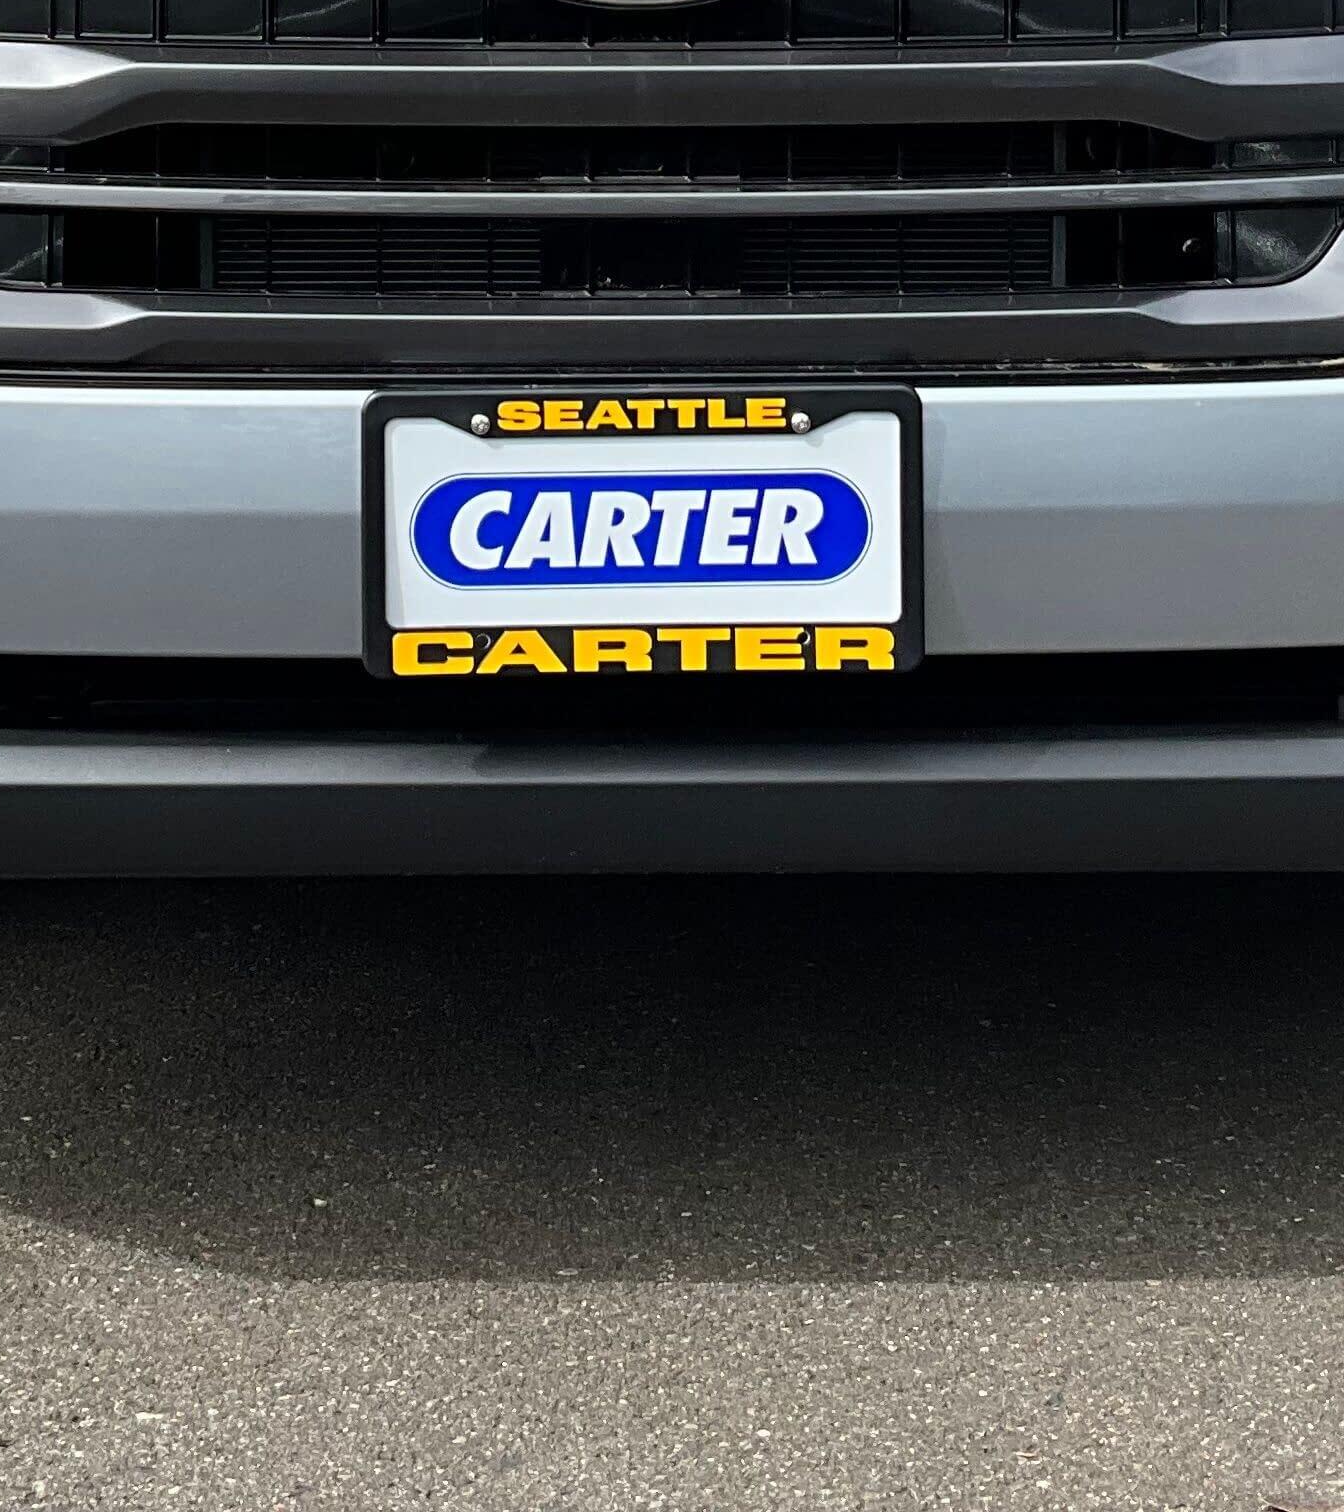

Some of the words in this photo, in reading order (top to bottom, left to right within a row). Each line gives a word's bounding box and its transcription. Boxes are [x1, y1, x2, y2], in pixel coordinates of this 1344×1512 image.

[496, 397, 787, 432] SEATTLE
[449, 488, 825, 570] CARTER
[391, 625, 896, 677] CARTER
